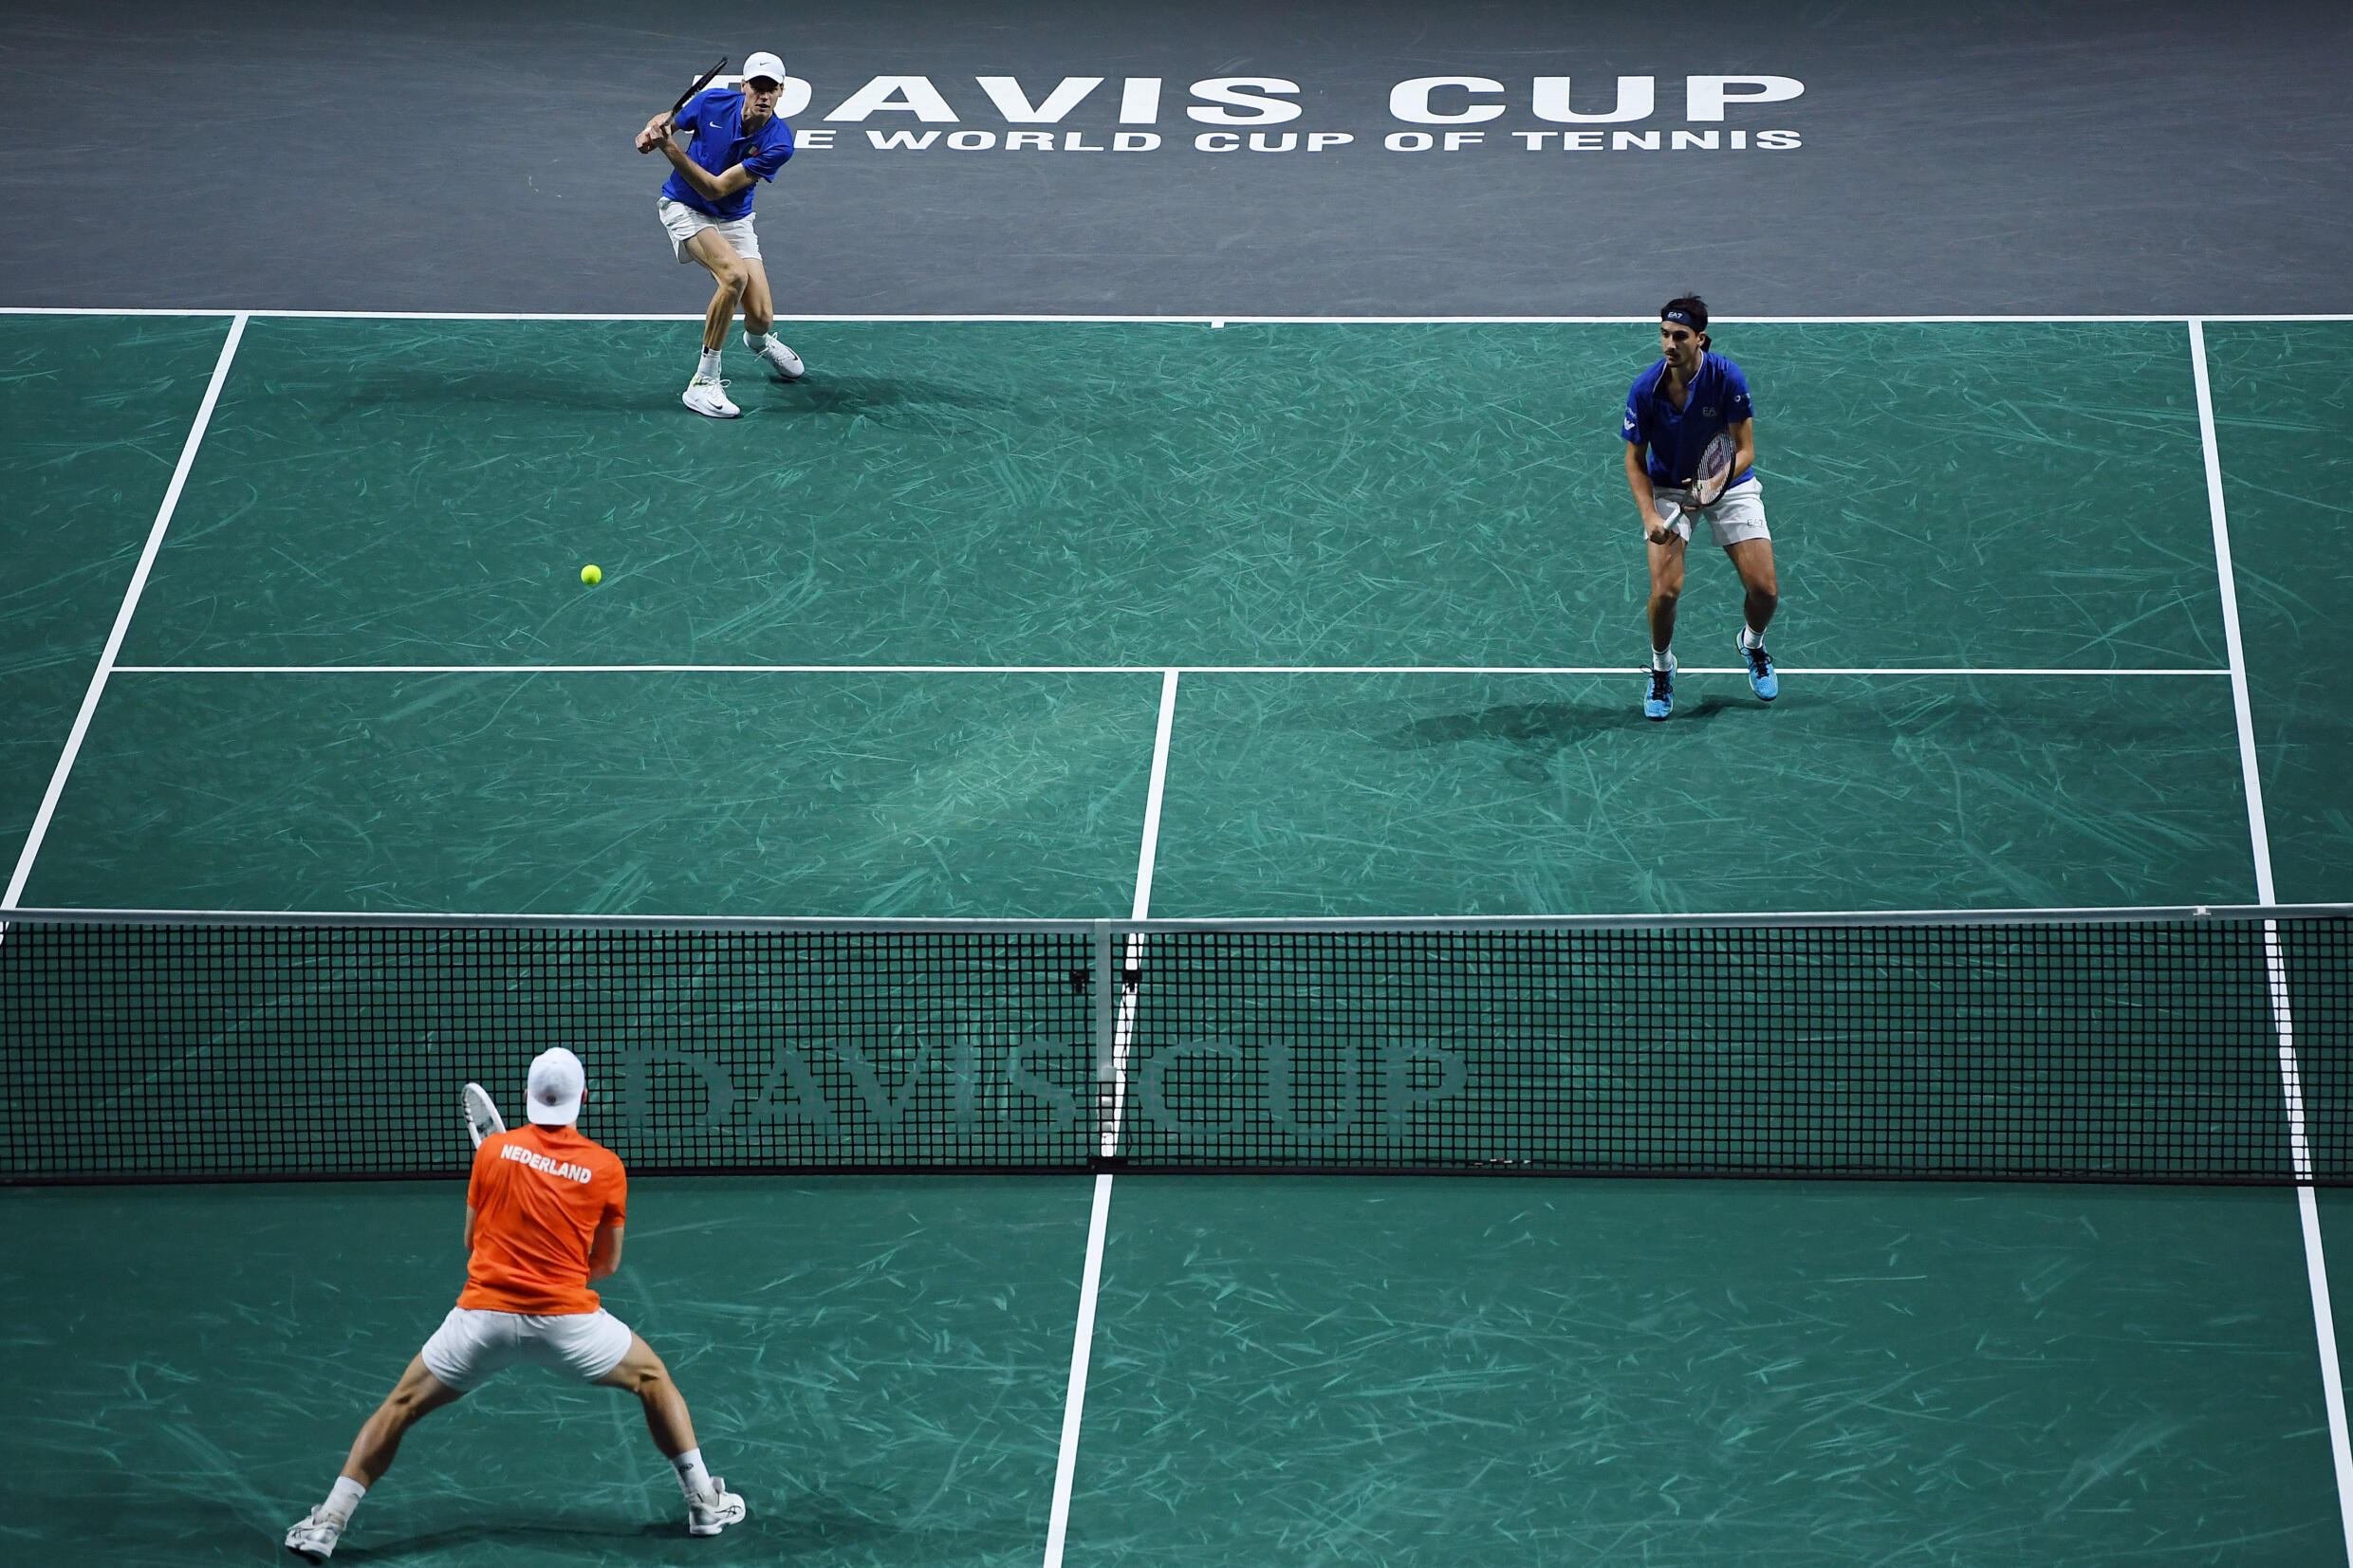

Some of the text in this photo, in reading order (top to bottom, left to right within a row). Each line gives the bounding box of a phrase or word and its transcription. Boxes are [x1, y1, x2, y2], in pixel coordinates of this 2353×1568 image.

[1389, 75, 1806, 125] CUP
[865, 129, 1804, 153] WORLD CUP OF TENNIS
[622, 1042, 1468, 1137] DAVIS CUP
[500, 1144, 592, 1185] NEDERLAND
